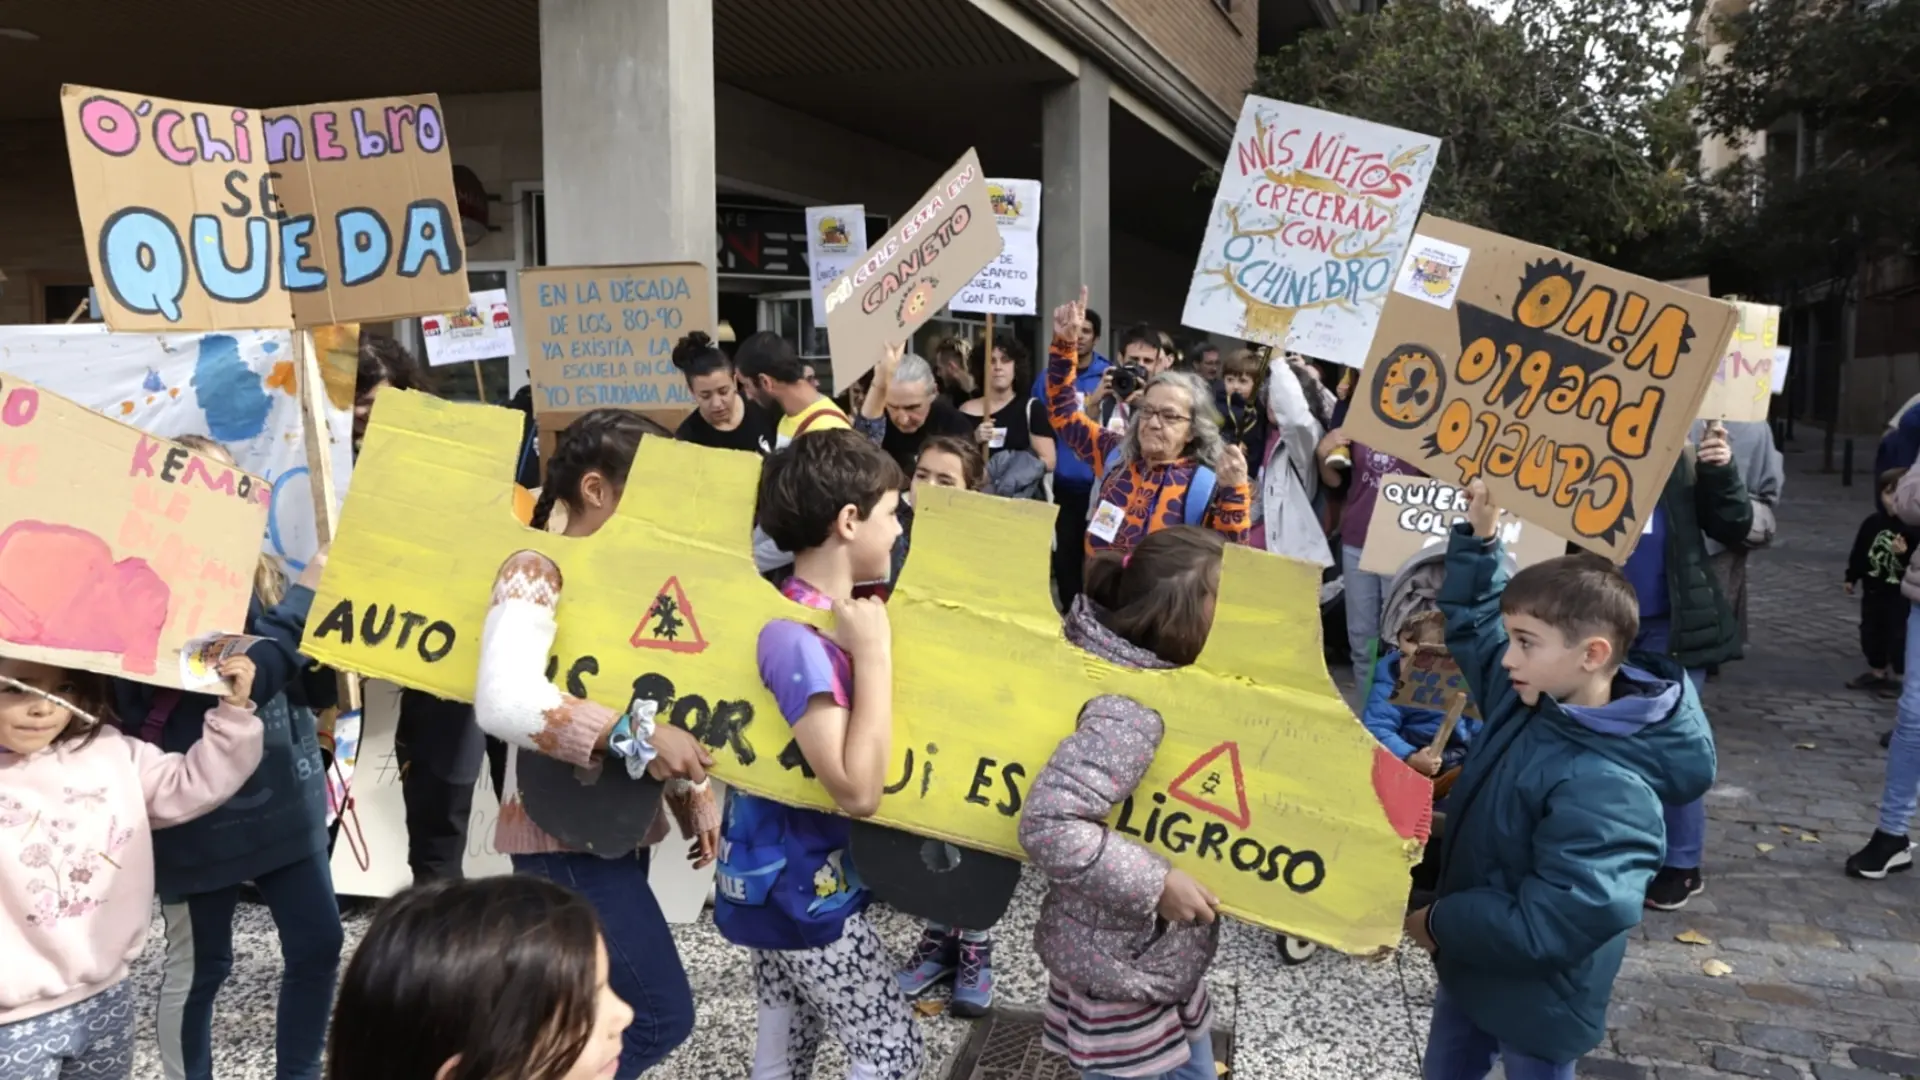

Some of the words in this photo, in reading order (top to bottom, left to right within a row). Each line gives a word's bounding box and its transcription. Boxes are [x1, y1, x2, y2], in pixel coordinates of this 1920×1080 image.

[221, 170, 287, 220] SE
[1281, 221, 1337, 253] CON
[98, 198, 463, 323] QUEDA
[861, 204, 972, 315] CANETO
[981, 267, 1028, 280] CANETO
[538, 283, 567, 307] EN
[576, 280, 601, 304] LA
[961, 291, 984, 304] CON
[988, 294, 1026, 307] FUTURO
[550, 314, 568, 335] DE
[578, 312, 612, 334] LOS
[542, 341, 564, 360] YA
[648, 337, 671, 356] LA
[563, 362, 627, 379] ESCUELA
[1436, 398, 1634, 538] Caneto
[965, 757, 1026, 817] ES
